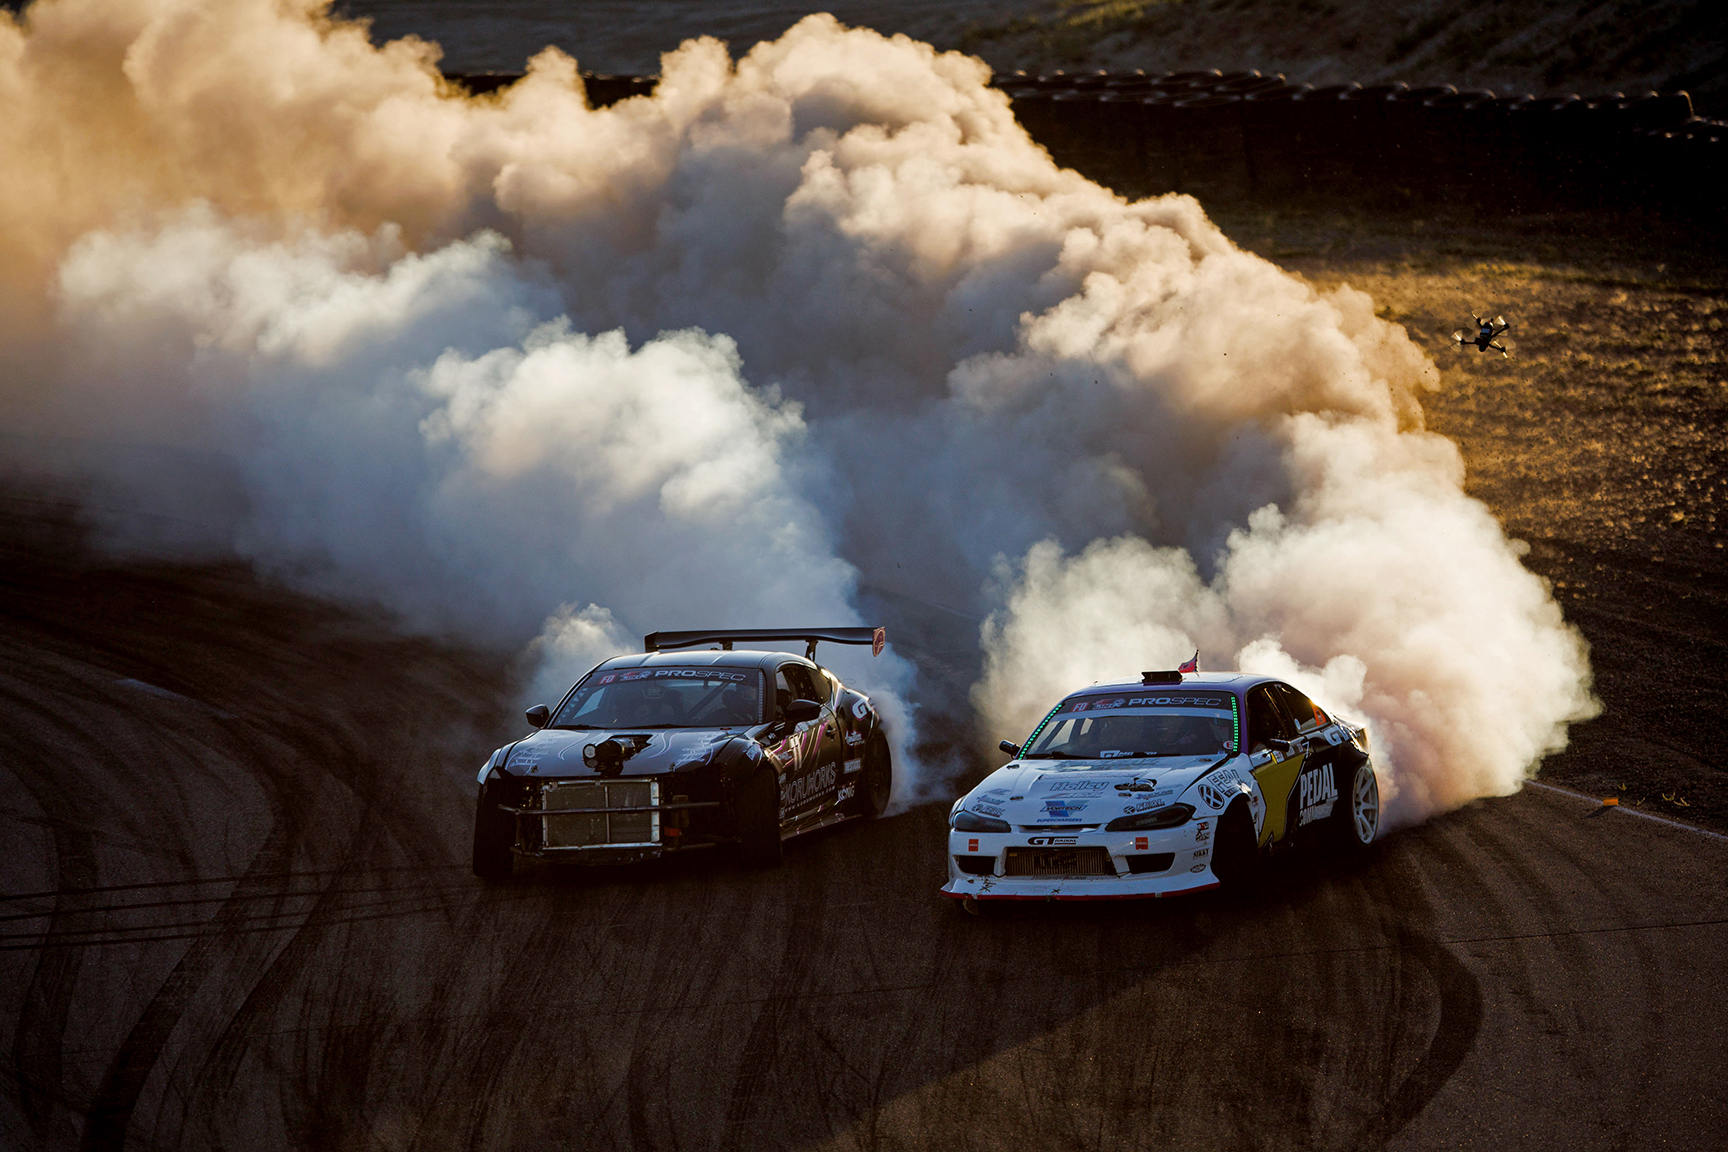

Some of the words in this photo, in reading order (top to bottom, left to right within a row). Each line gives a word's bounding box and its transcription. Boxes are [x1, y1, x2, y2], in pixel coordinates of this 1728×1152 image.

[600, 674, 615, 684] FD
[654, 670, 746, 682] PROSPEC
[1072, 702, 1088, 712] FD
[1128, 697, 1221, 706] PROSPEC
[1049, 781, 1110, 792] Holley
[1300, 762, 1338, 810] PEDAL
